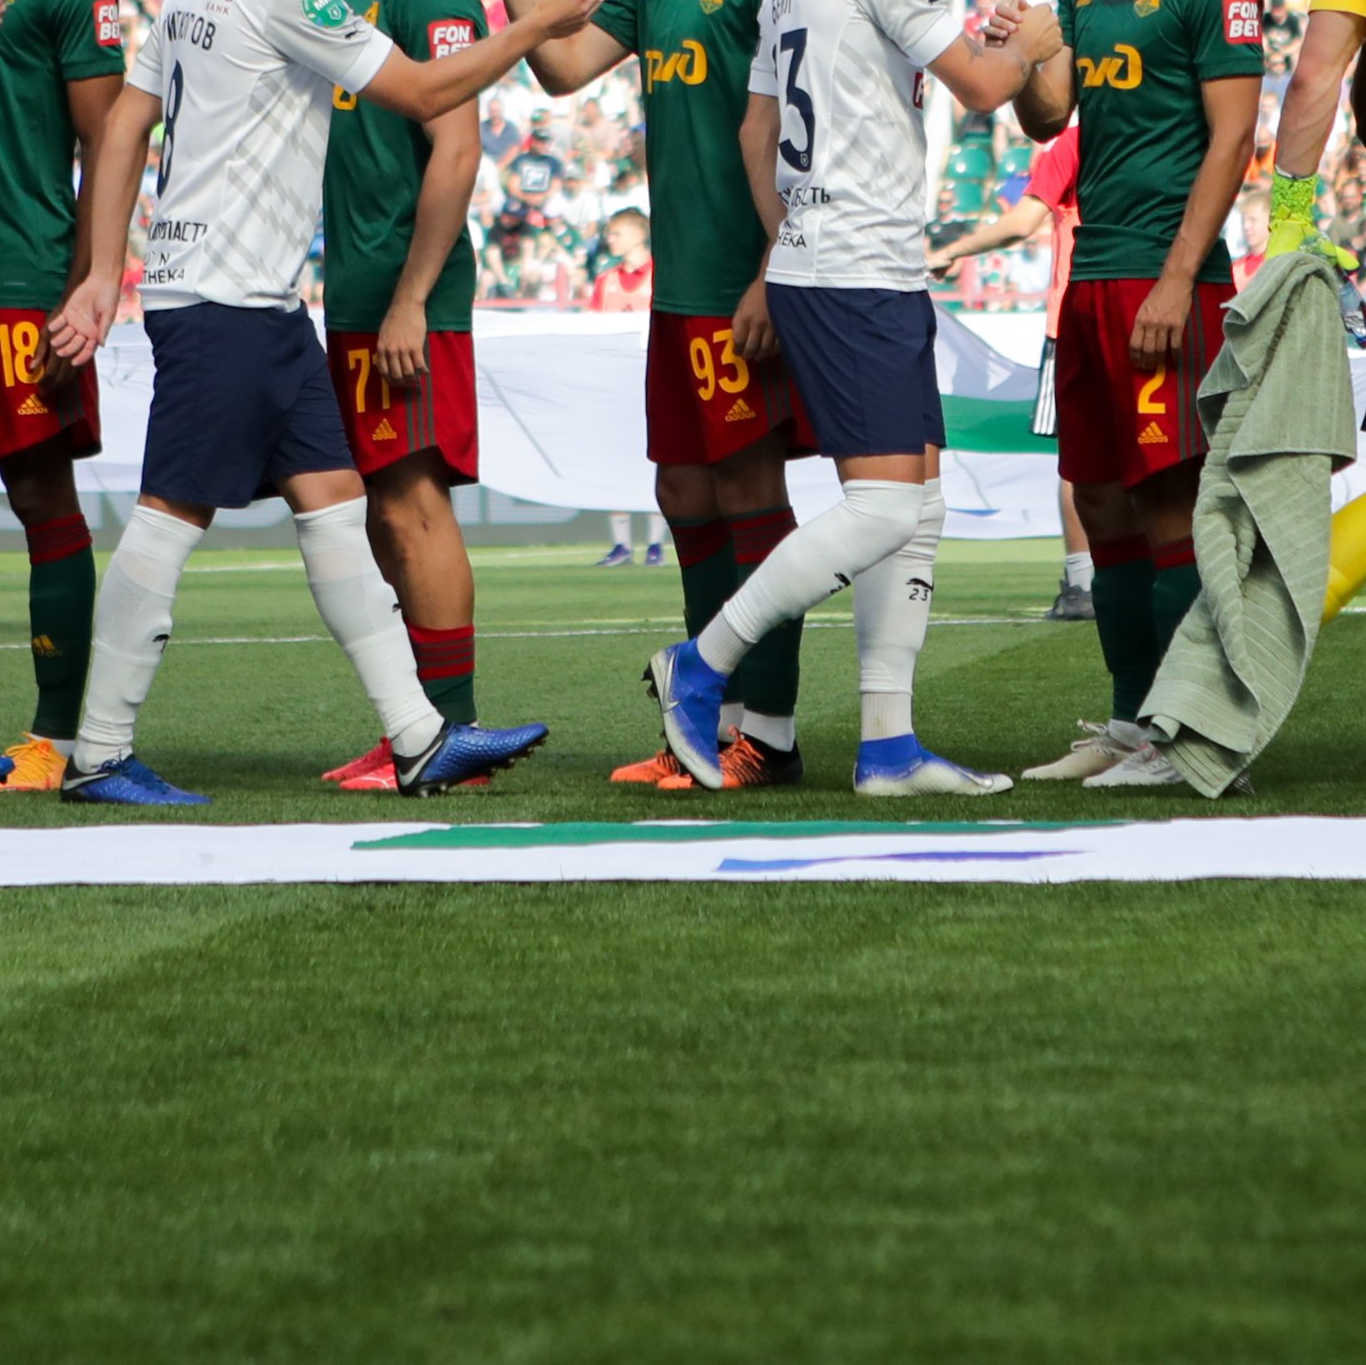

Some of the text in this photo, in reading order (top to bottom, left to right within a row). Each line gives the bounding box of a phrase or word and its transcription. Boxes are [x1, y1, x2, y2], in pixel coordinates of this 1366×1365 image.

[1227, 1, 1259, 20] FON
[432, 25, 471, 45] FON
[1228, 19, 1260, 39] BET
[689, 328, 750, 401] 93
